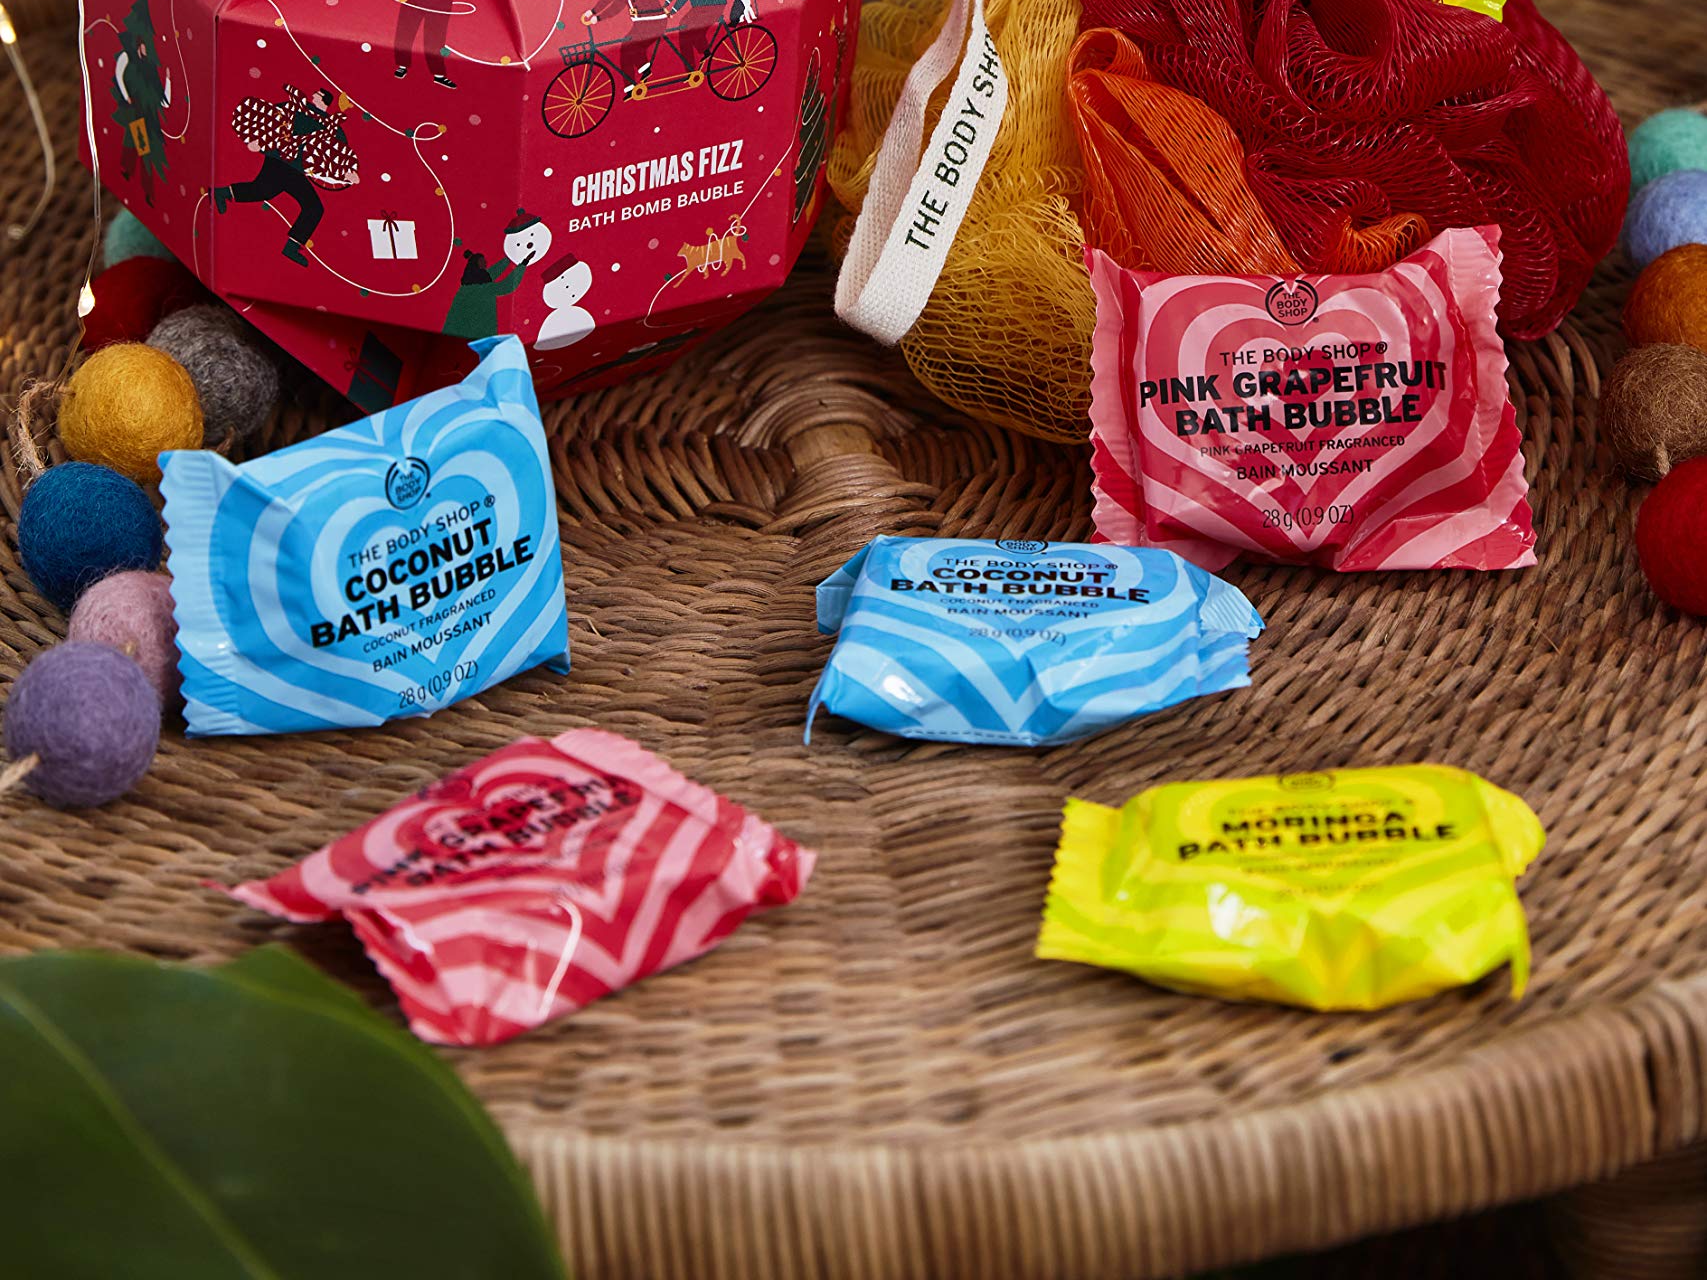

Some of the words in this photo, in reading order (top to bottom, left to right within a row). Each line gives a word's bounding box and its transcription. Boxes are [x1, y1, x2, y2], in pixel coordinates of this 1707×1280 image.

[571, 151, 694, 207] CHRISTMAS
[698, 139, 744, 178] FIZZ
[904, 190, 949, 250] THE
[934, 97, 985, 188] BODY
[568, 210, 615, 233] BATH
[621, 198, 671, 221] BOMB
[677, 180, 744, 208] BAUBLE
[1277, 298, 1307, 309] BODY
[1283, 292, 1300, 300] THE
[1278, 308, 1308, 318] SHOP
[1220, 351, 1257, 366] THE
[1263, 346, 1315, 363] BODY
[1139, 374, 1221, 408] PINK
[1233, 360, 1447, 398] GRAPEFRUIT
[1176, 404, 1271, 436] BATH
[1284, 394, 1422, 429] BUBBLE
[1200, 445, 1230, 457] PINK
[1235, 440, 1315, 455] GRAPEFRUIT
[1319, 435, 1405, 451] FRAGRANCED
[1237, 466, 1276, 480] BAIN
[1282, 459, 1373, 477] MOUSSANT
[1262, 509, 1280, 528] 28
[349, 545, 381, 569] THE
[386, 524, 431, 555] BODY
[345, 518, 492, 603] COCONUT
[943, 558, 980, 567] THE
[987, 559, 1041, 569] BODY
[932, 567, 1109, 584] COCONUT
[310, 595, 400, 648] BATH
[409, 535, 534, 610] BUBBLE
[891, 579, 988, 595] BATH
[1002, 582, 1150, 604] BUBBLE
[363, 623, 416, 653] COCONUT
[419, 589, 496, 628] FRAGRANCED
[947, 607, 988, 615] BAIN
[994, 608, 1090, 619] MOUSSANT
[373, 648, 407, 673] BAIN
[411, 612, 492, 655] MOUSSANT
[398, 688, 415, 709] 28
[1222, 811, 1406, 834] MORINGA
[1299, 824, 1457, 846] BUBBLE
